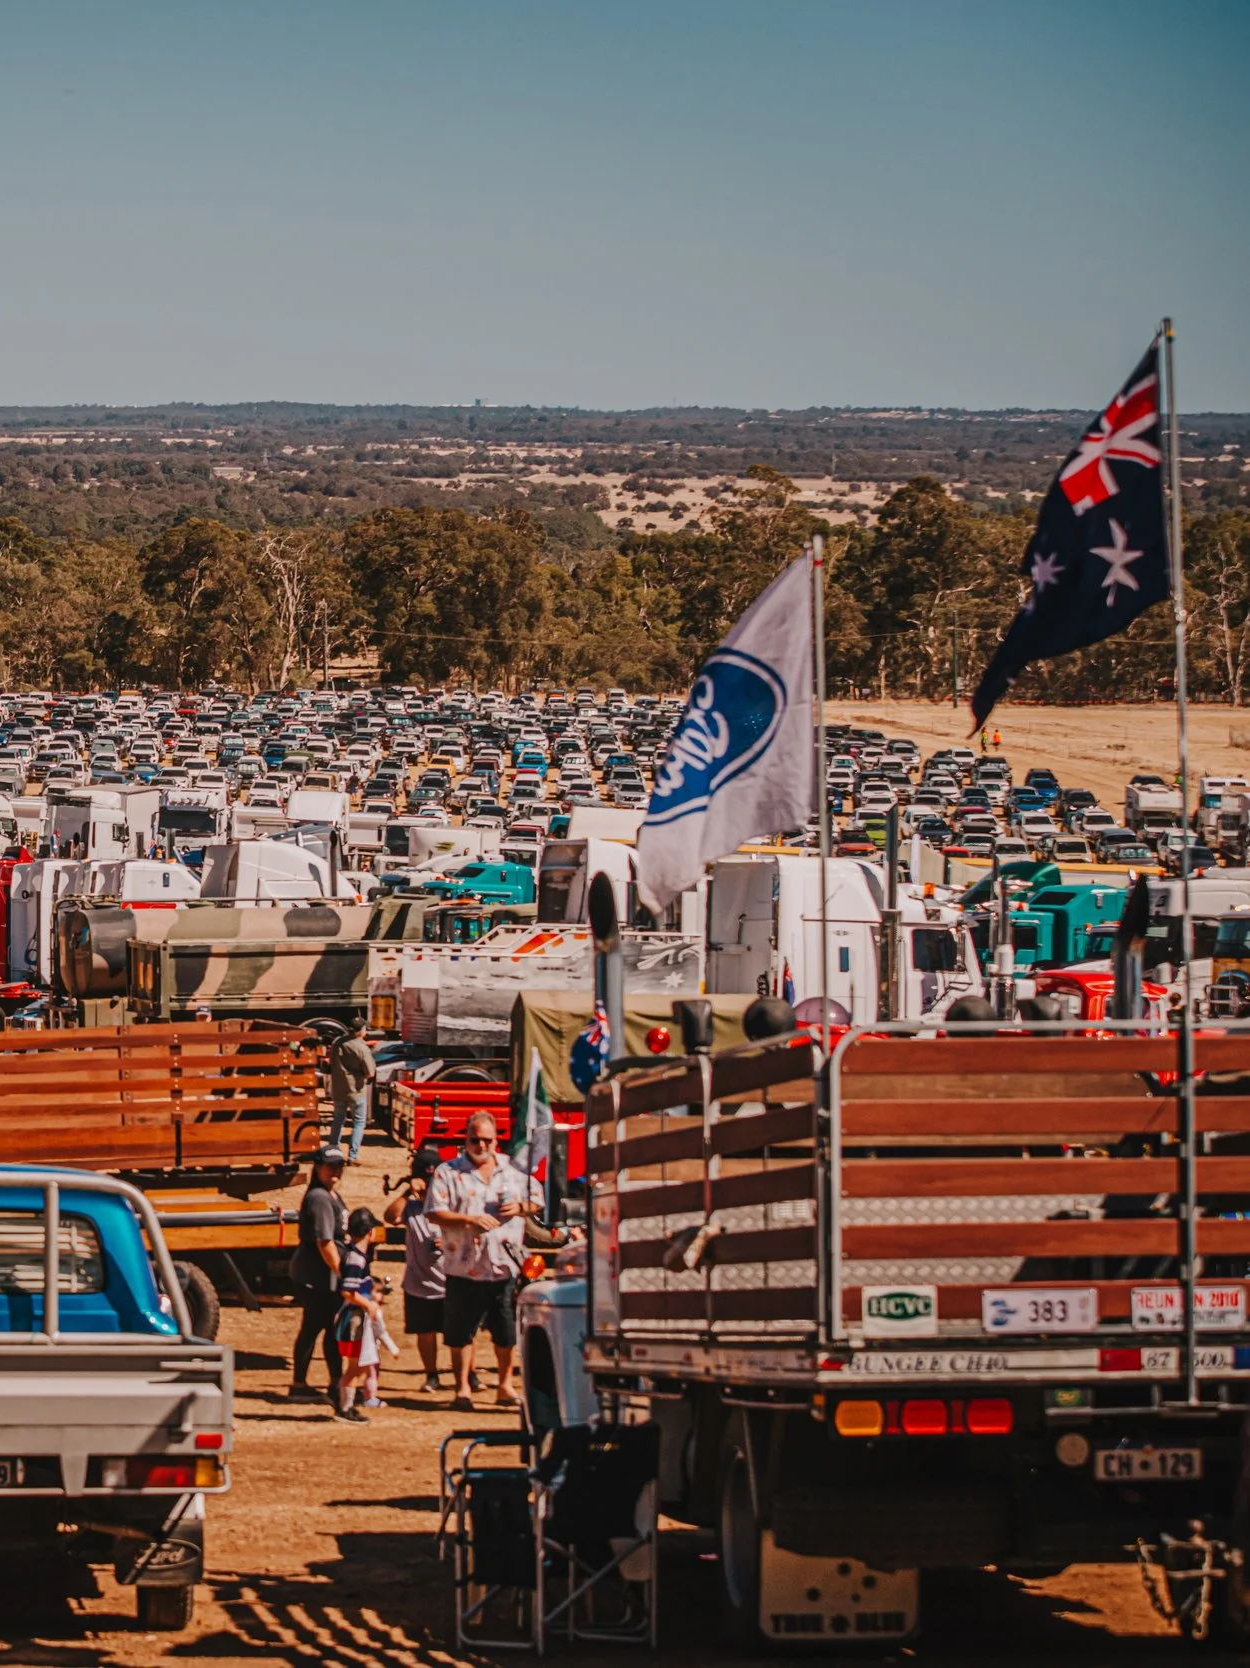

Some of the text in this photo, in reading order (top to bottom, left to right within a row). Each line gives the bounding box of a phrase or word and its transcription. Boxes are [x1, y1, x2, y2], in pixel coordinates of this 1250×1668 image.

[870, 1297, 931, 1315] HCVC
[1136, 1291, 1203, 1309] REUNIN
[1028, 1300, 1068, 1322] 383
[1104, 1453, 1195, 1476] CH 129
